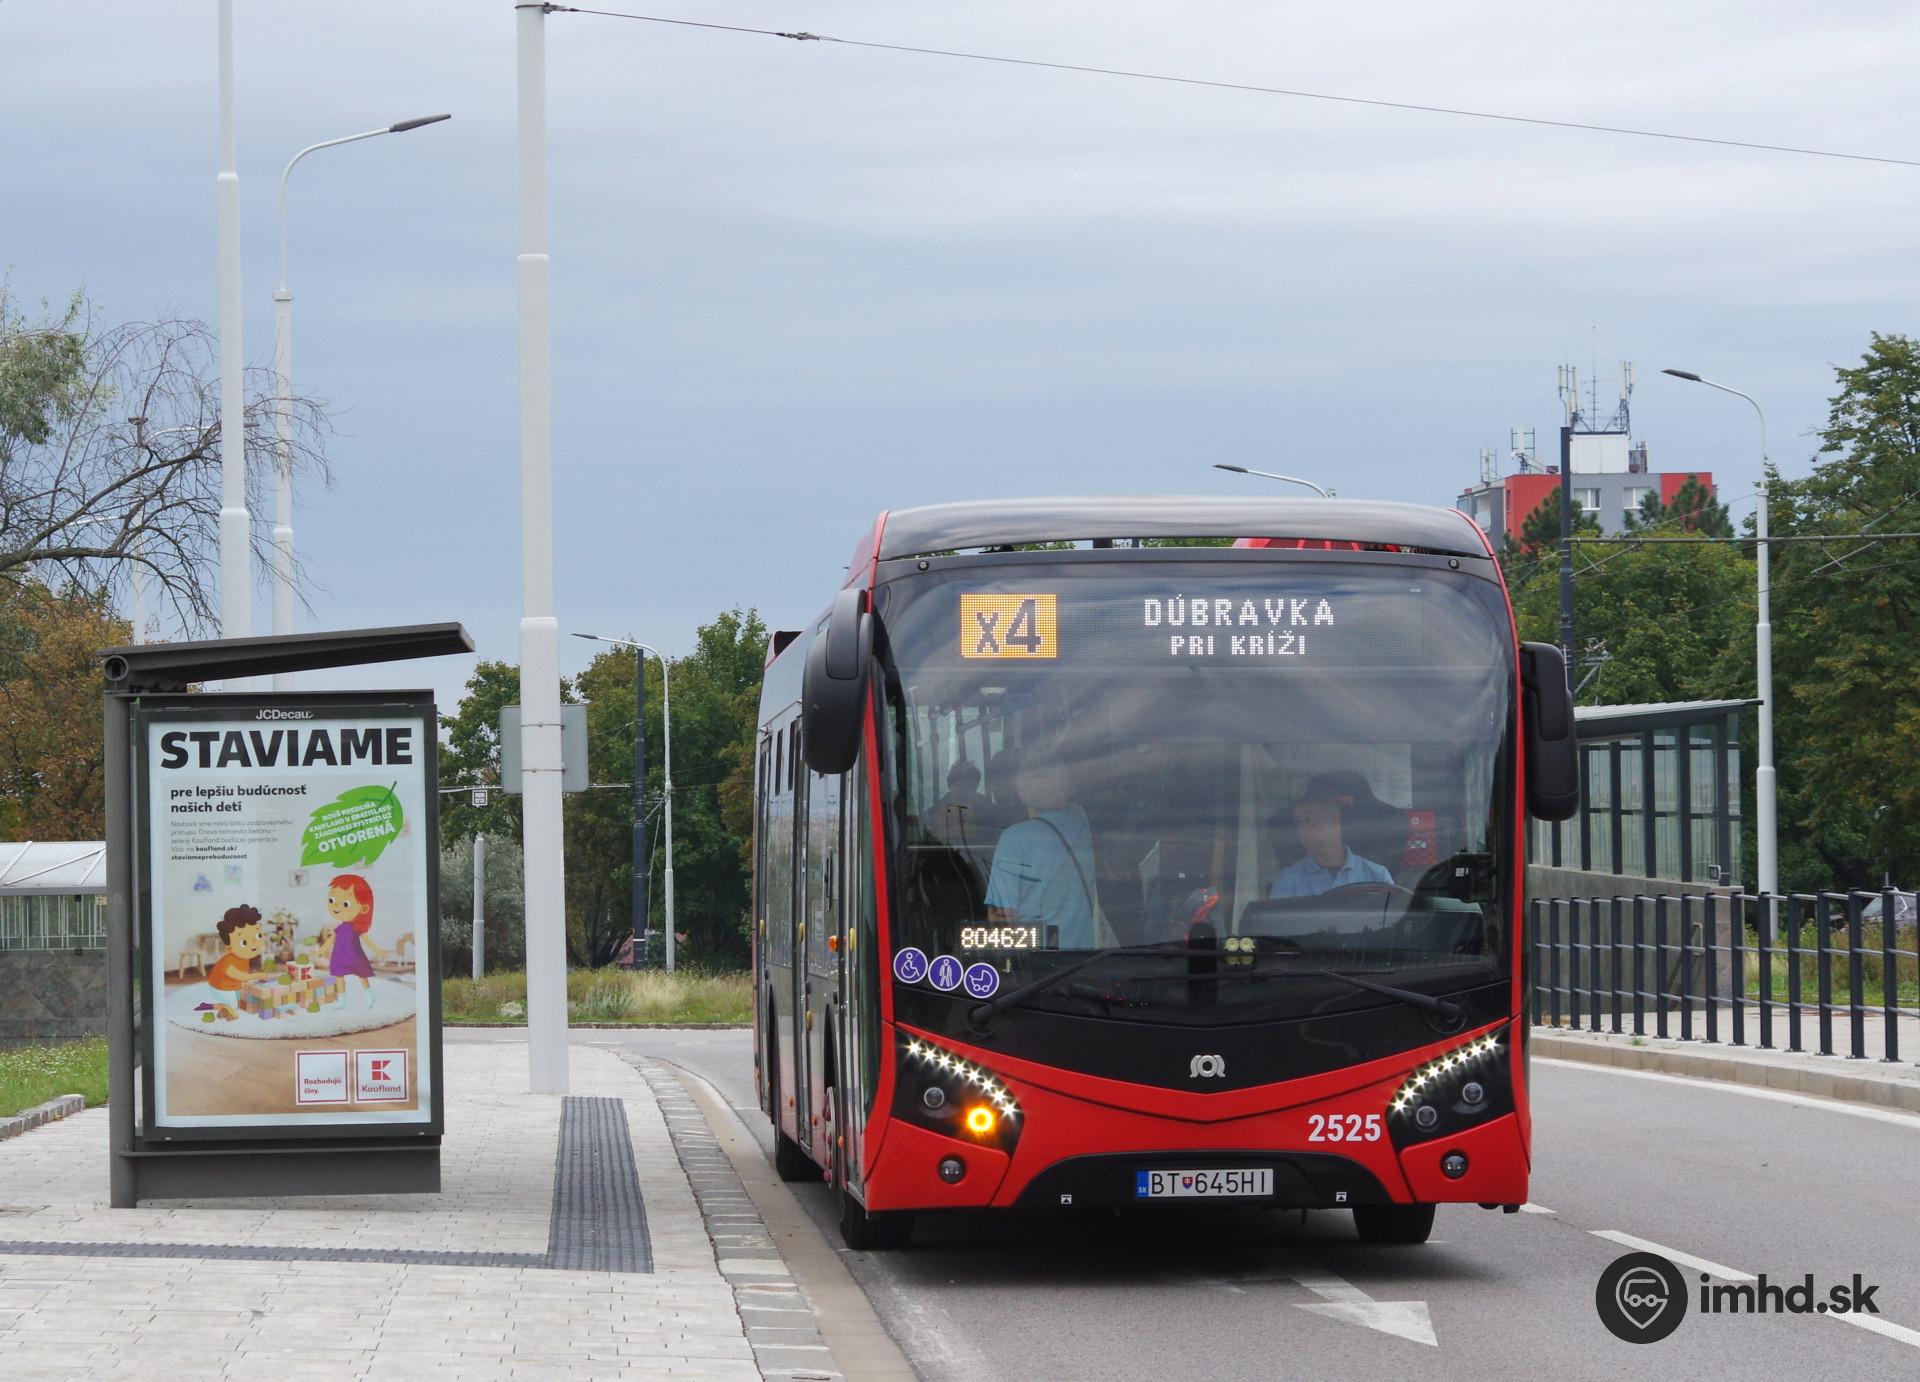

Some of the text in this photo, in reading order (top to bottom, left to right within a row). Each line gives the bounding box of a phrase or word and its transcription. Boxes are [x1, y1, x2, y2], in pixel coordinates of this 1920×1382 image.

[1144, 593, 1335, 626] DÚBRAVKA
[1171, 630, 1306, 655] PRI KRÍŽI
[160, 727, 413, 769] STAVIAME
[170, 784, 307, 800] pre lepšiu budúcnosť
[170, 801, 242, 813] našich detí
[318, 820, 397, 853] OTVORENÁ
[960, 927, 1037, 948] 804621
[361, 1084, 401, 1094] Kaufland
[1308, 1114, 1382, 1142] 2525
[1151, 1172, 1180, 1195] BT
